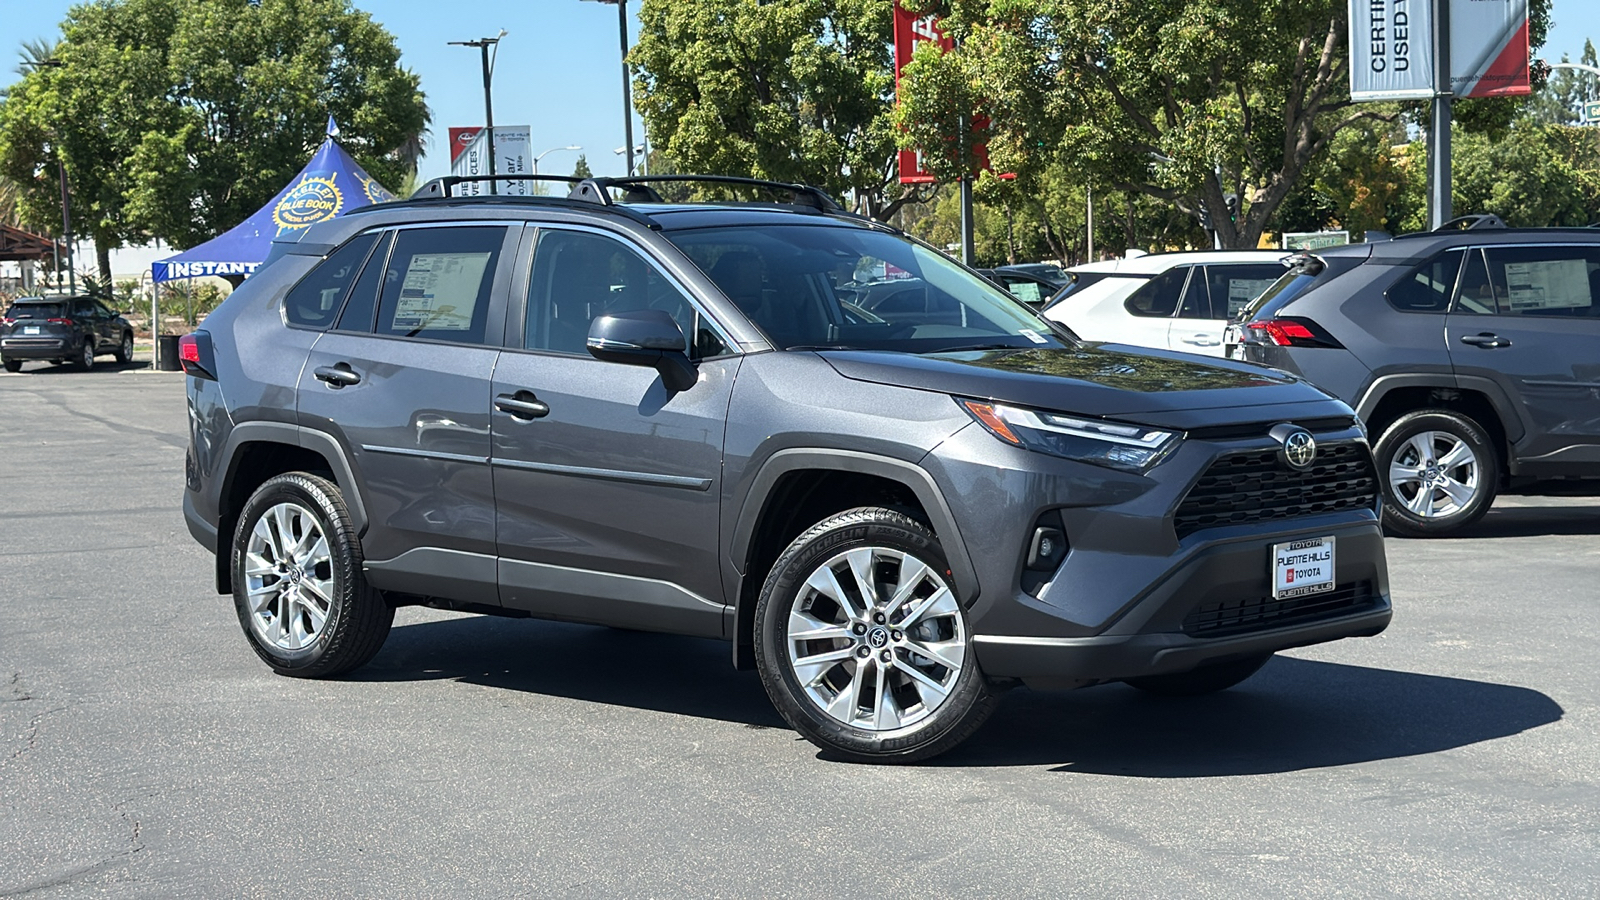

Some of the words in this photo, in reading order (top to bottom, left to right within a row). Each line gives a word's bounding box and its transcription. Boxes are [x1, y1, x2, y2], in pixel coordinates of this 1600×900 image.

[1394, 11, 1409, 72] USED
[470, 150, 479, 196] VECLES
[505, 156, 516, 189] Yar/
[292, 184, 334, 199] KELLEY
[281, 200, 306, 211] BLUE
[305, 199, 335, 211] BOOK
[167, 262, 259, 279] INSTANT
[800, 526, 867, 562] MICHELIN
[1291, 540, 1322, 549] TOYOTA
[1278, 554, 1308, 566] PUENTE
[1308, 551, 1330, 562] HILLS
[1295, 567, 1321, 579] TOYOTA
[1280, 586, 1309, 597] PUENTE
[1310, 582, 1332, 593] HILLS
